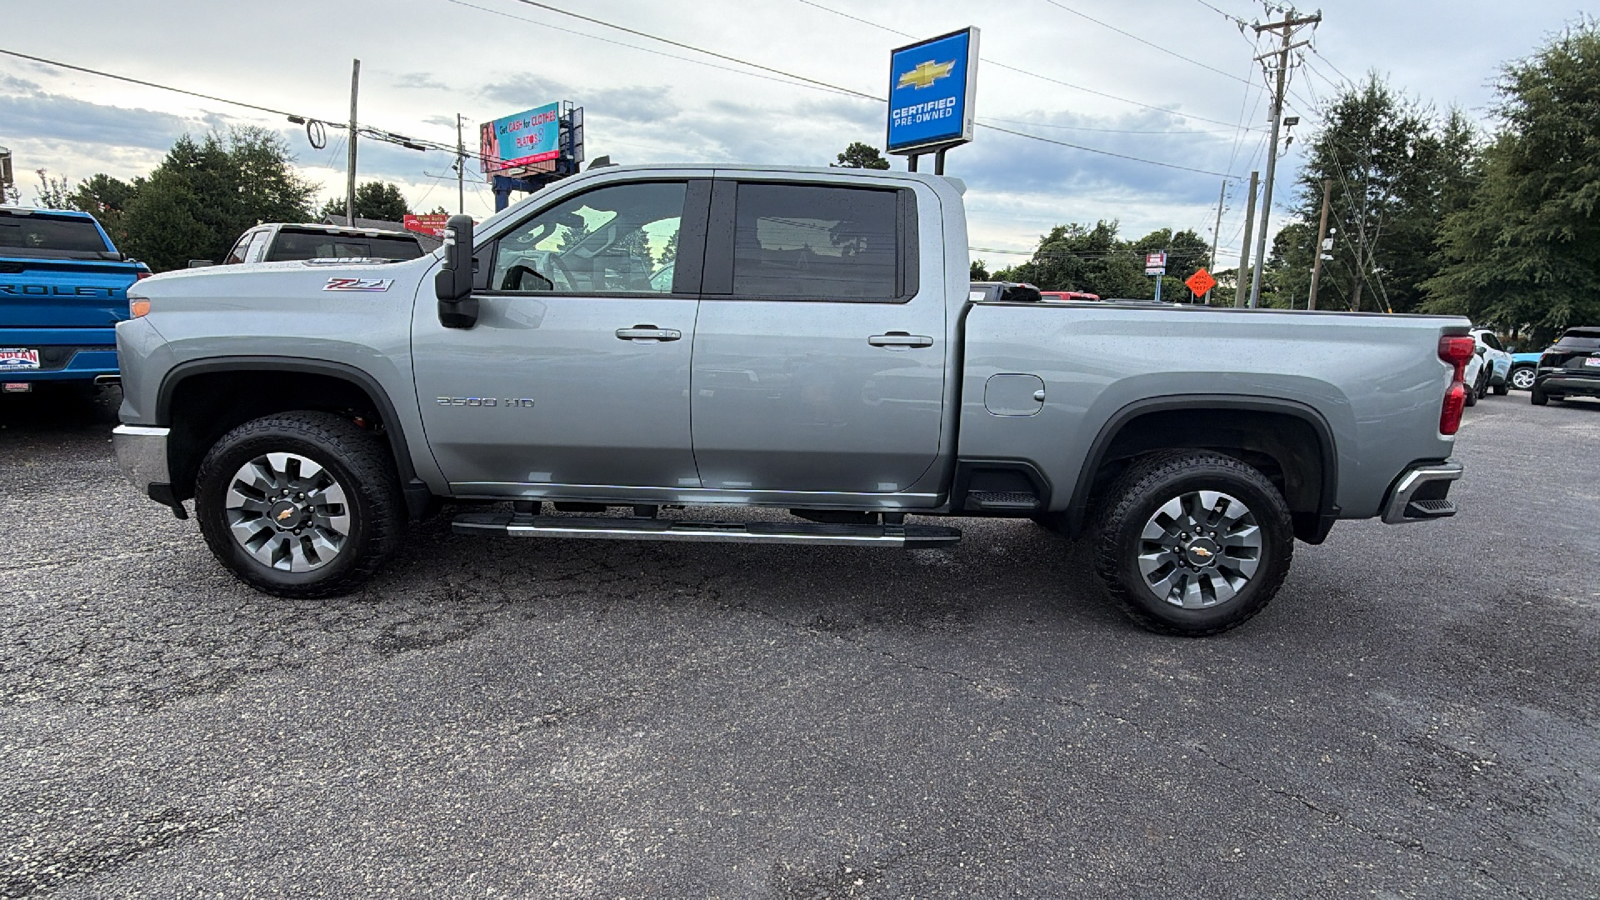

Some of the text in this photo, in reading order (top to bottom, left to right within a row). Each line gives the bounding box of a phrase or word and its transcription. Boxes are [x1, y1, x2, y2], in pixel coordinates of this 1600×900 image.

[892, 96, 956, 119] CERTIFIED
[894, 107, 953, 128] PRE-OWNED
[499, 109, 557, 135] Get CASH for CLOTHES
[322, 277, 395, 292] Z71
[437, 396, 535, 408] 2500 HD
